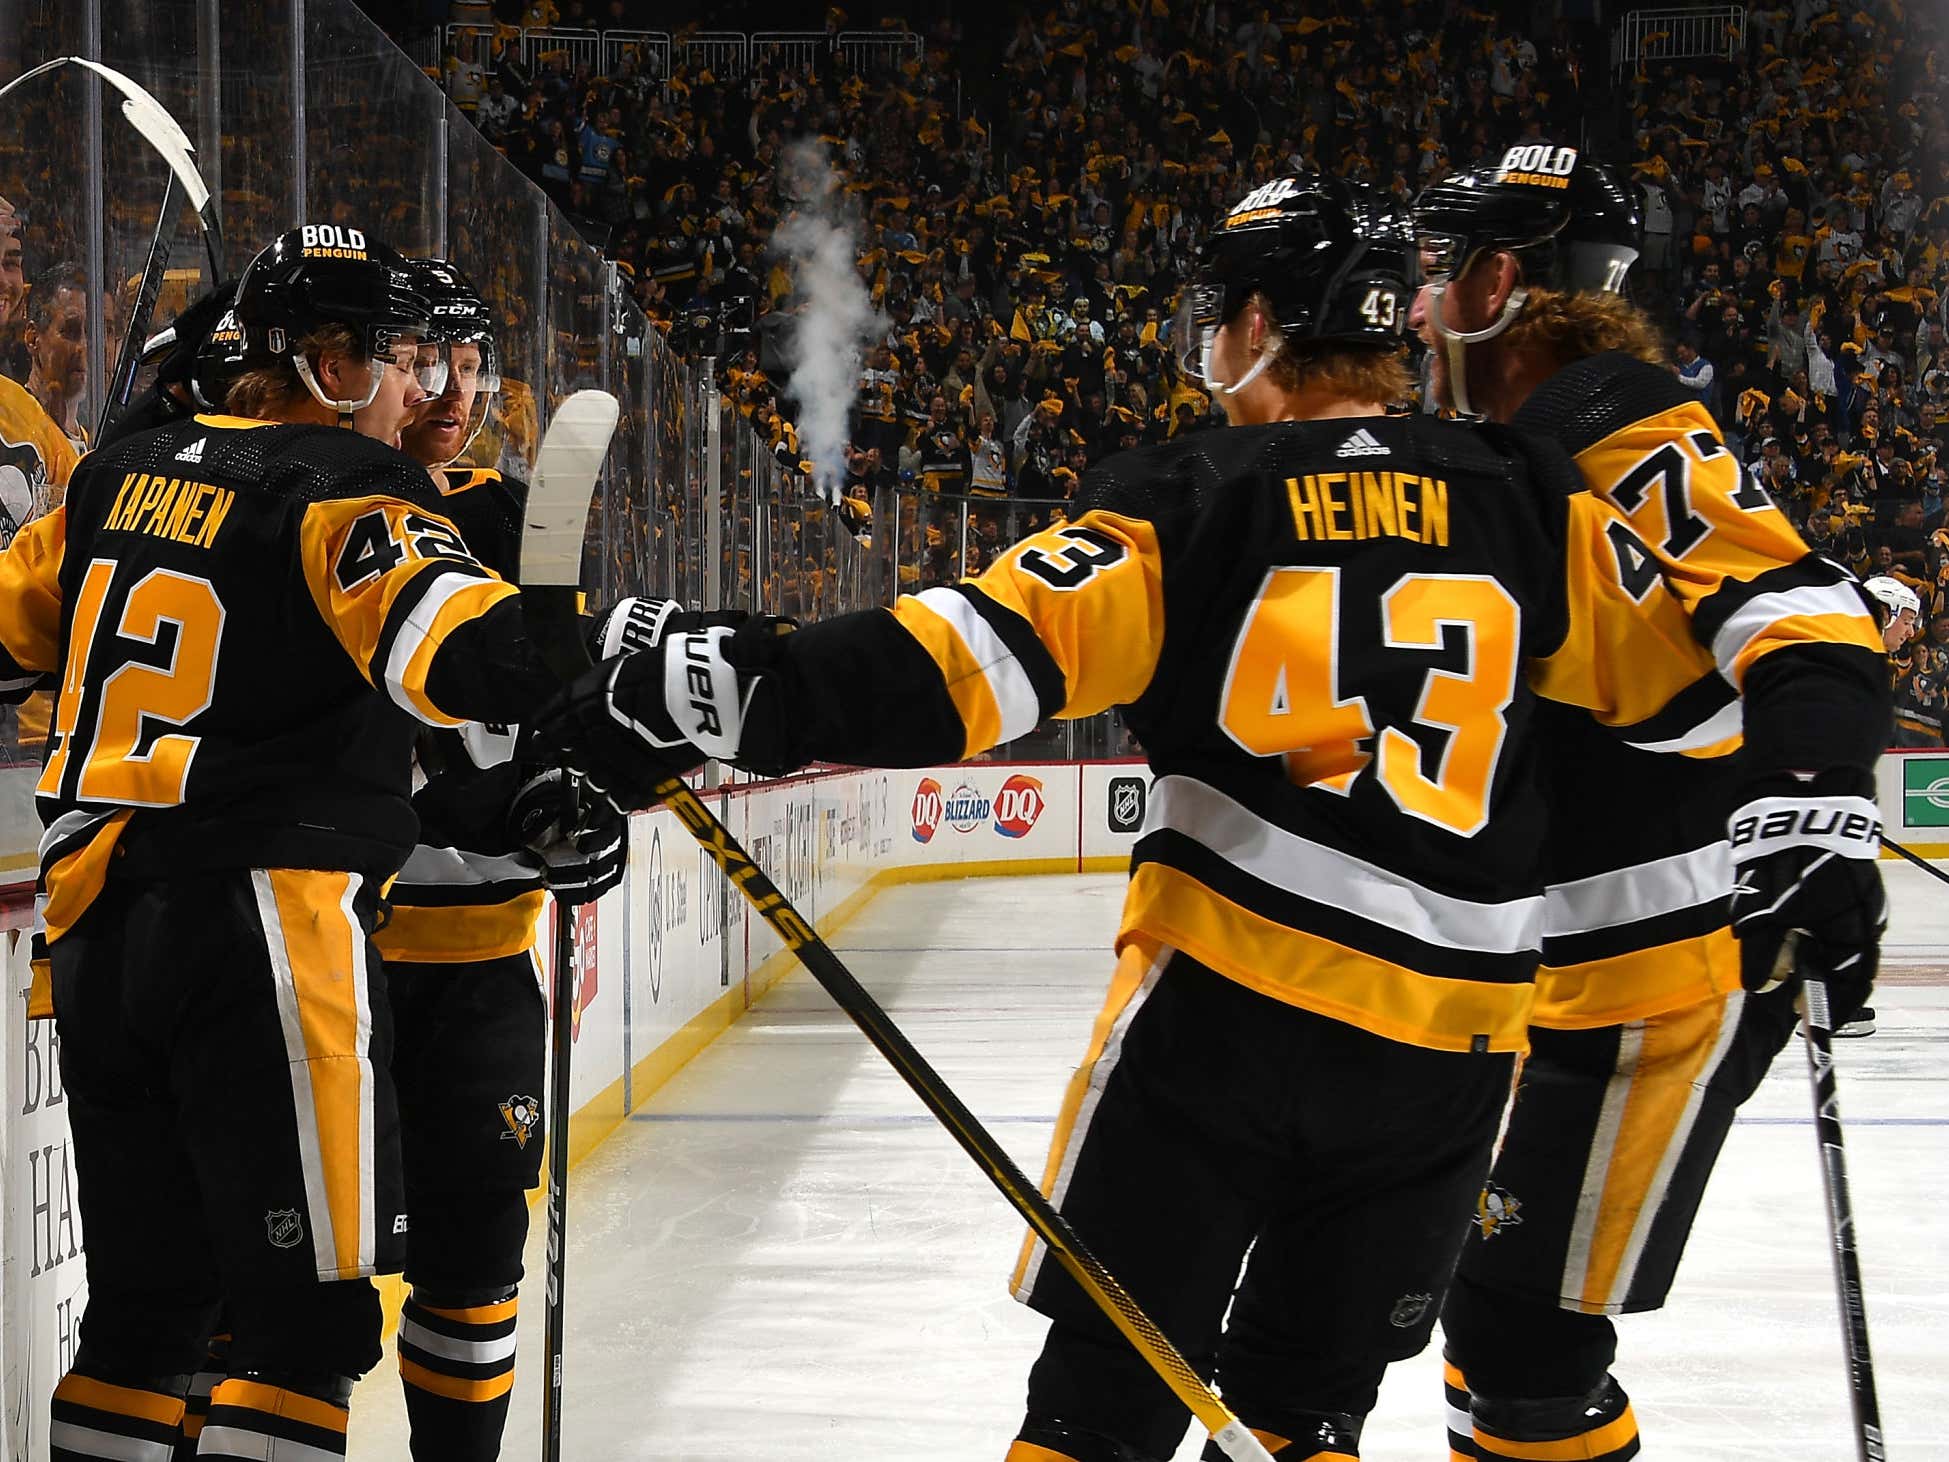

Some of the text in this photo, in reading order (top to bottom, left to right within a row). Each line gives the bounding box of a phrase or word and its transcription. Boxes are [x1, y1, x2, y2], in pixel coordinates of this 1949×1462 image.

[1502, 146, 1577, 175] BOLD
[1231, 179, 1297, 214] BOLD
[1499, 173, 1570, 189] PENGUIN
[302, 224, 366, 250] BOLD
[303, 248, 368, 261] PENGUIN
[432, 270, 453, 284] 5
[216, 309, 237, 331] BO
[433, 306, 477, 315] CCM
[1361, 290, 1396, 326] 43
[212, 331, 241, 342] PENG
[1336, 447, 1391, 457] adidas
[103, 472, 235, 549] KAPANEN
[1286, 472, 1449, 547] HEINEN
[34, 558, 227, 808] 42
[1218, 566, 1521, 839] 43
[915, 792, 938, 829] DQ
[944, 798, 990, 821] BLIZZARD
[1001, 788, 1036, 824] DQ
[1732, 808, 1882, 848] BAUER
[655, 777, 816, 951] EXUS
